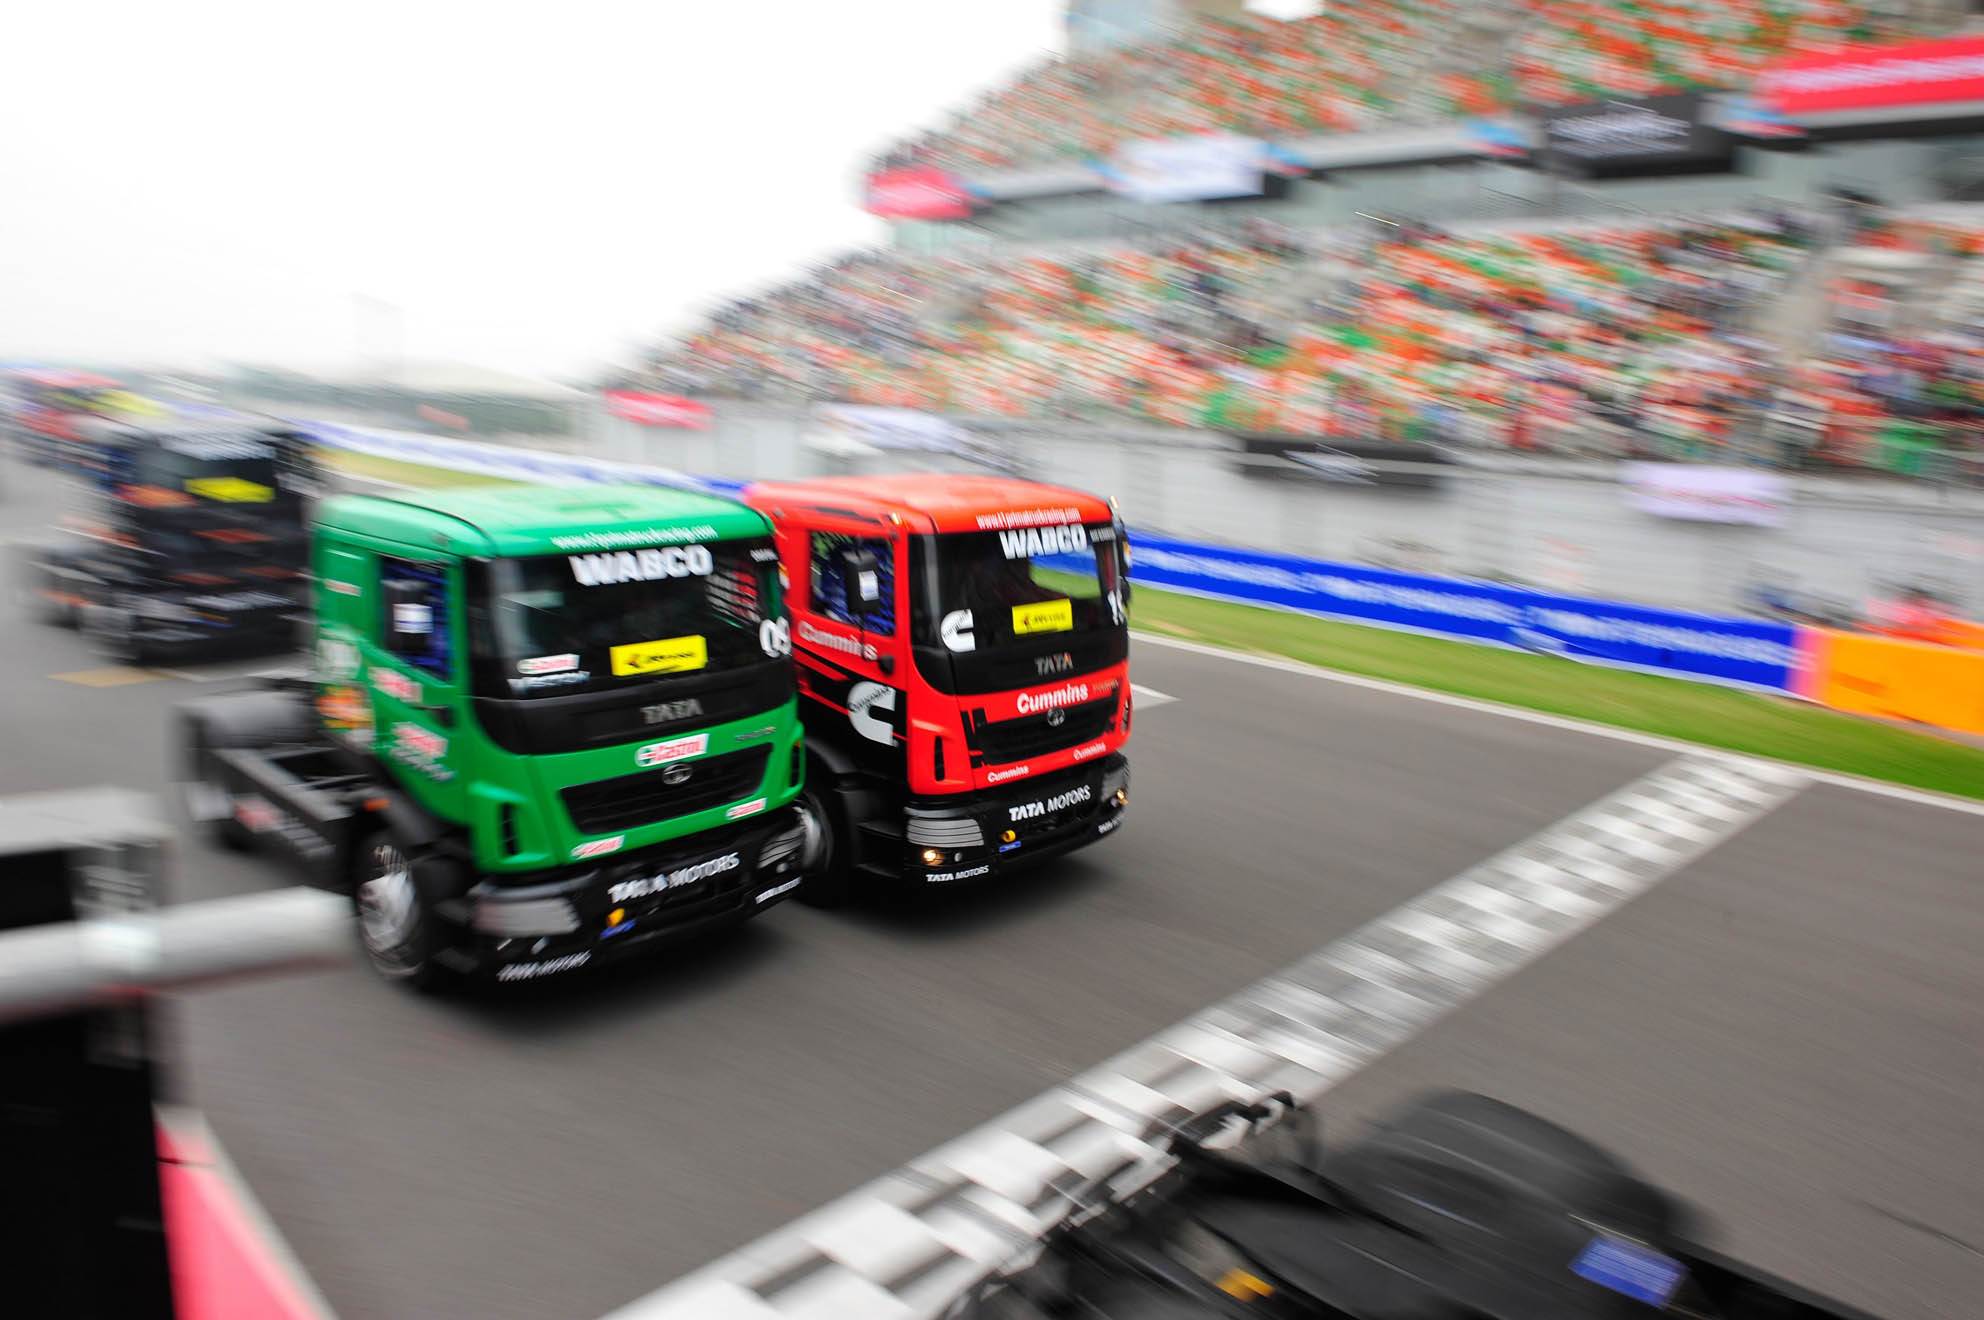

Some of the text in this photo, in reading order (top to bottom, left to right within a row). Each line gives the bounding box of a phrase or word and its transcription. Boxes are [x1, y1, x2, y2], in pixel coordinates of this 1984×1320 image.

[998, 523, 1088, 560] WABCO
[568, 544, 714, 586] WABCO
[1034, 651, 1074, 676] TATA
[640, 699, 704, 724] TATA
[1017, 683, 1089, 714] Cummins
[987, 765, 1030, 783] Cummins
[1008, 784, 1092, 822] TATA MOTORS
[666, 852, 740, 889] MOTORS
[926, 864, 990, 882] TATA MOTORS
